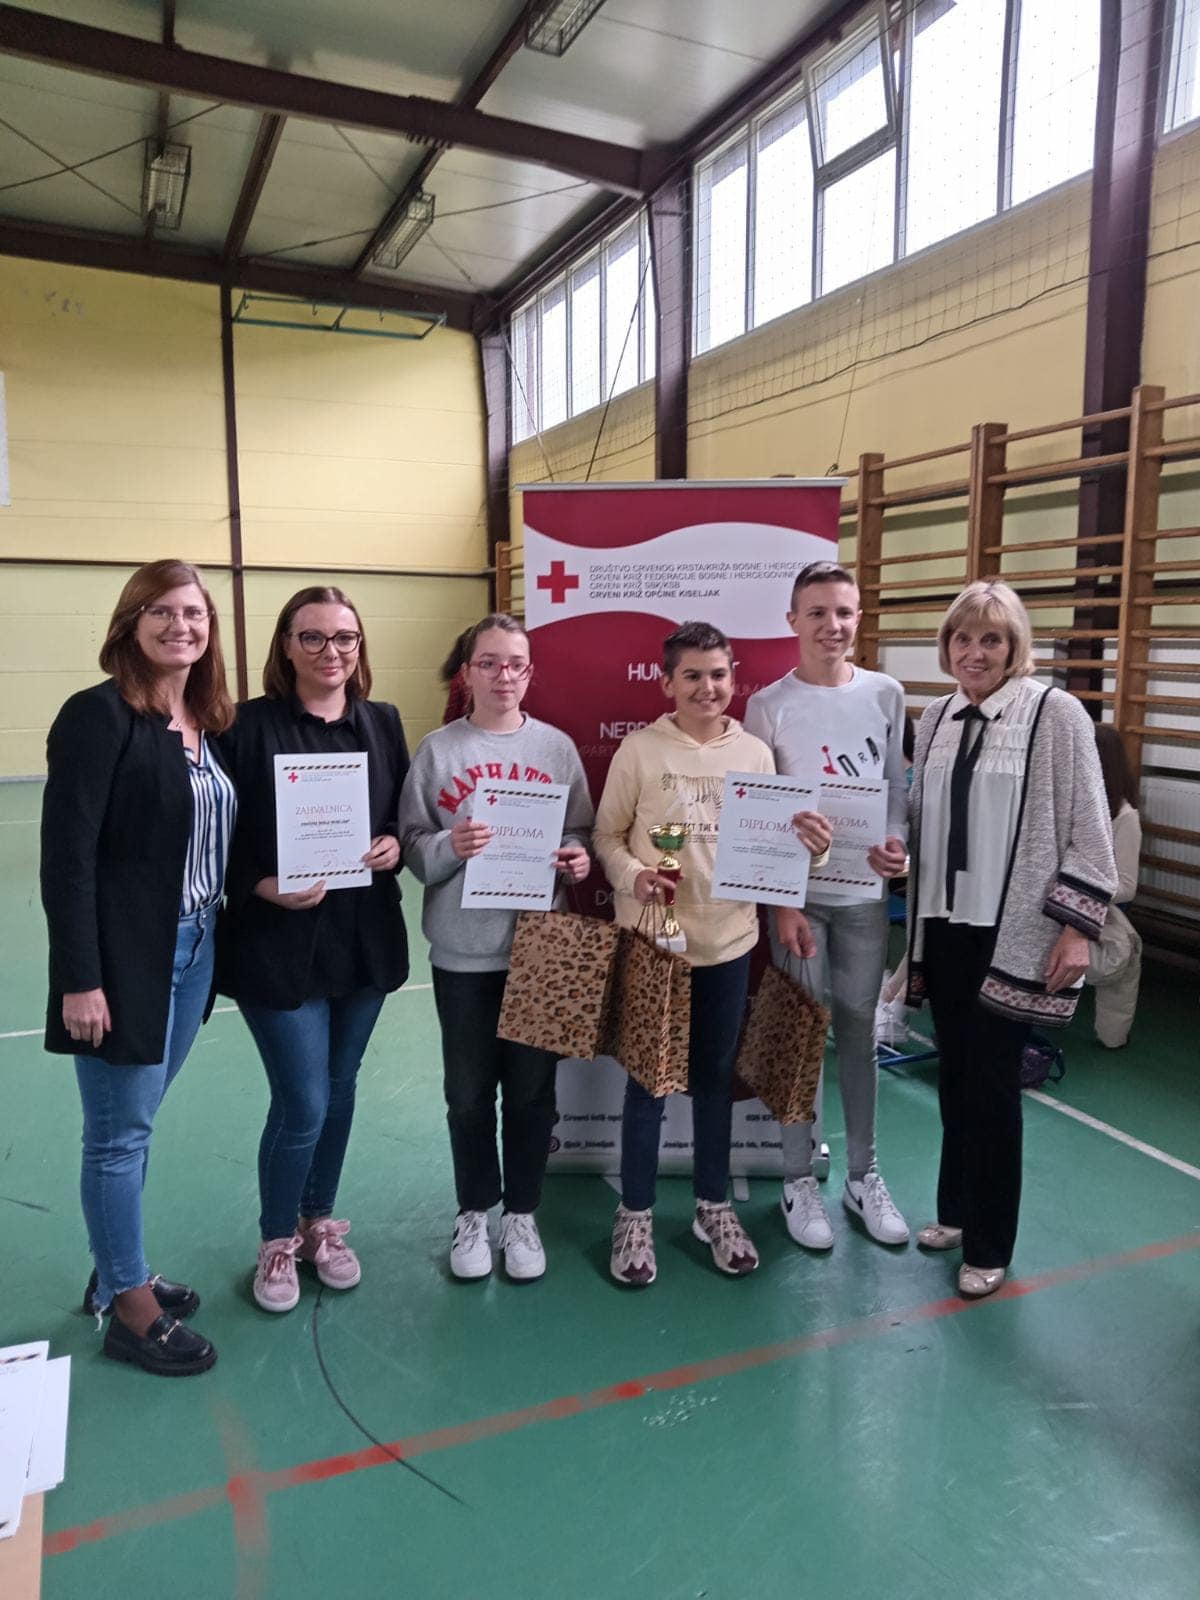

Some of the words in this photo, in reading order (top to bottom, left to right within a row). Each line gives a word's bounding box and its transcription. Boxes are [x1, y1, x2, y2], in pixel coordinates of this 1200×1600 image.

[589, 564, 631, 573] DRUŠTVO
[632, 564, 675, 573] CRVENOG
[732, 562, 762, 571] BOSNE
[589, 573, 620, 582] CRVENI
[623, 571, 641, 581] KRIŽ
[644, 571, 696, 581] FEDERACIJE
[698, 570, 728, 580] BOSNE
[589, 582, 620, 590] CRVENI
[623, 580, 641, 589] KRIŽ
[589, 591, 621, 599] CRVENI
[623, 589, 642, 599] KRIŽ
[644, 590, 677, 598] OPĆINE
[679, 589, 720, 598] KISELJAK
[295, 804, 353, 816] ZAHVALNICA
